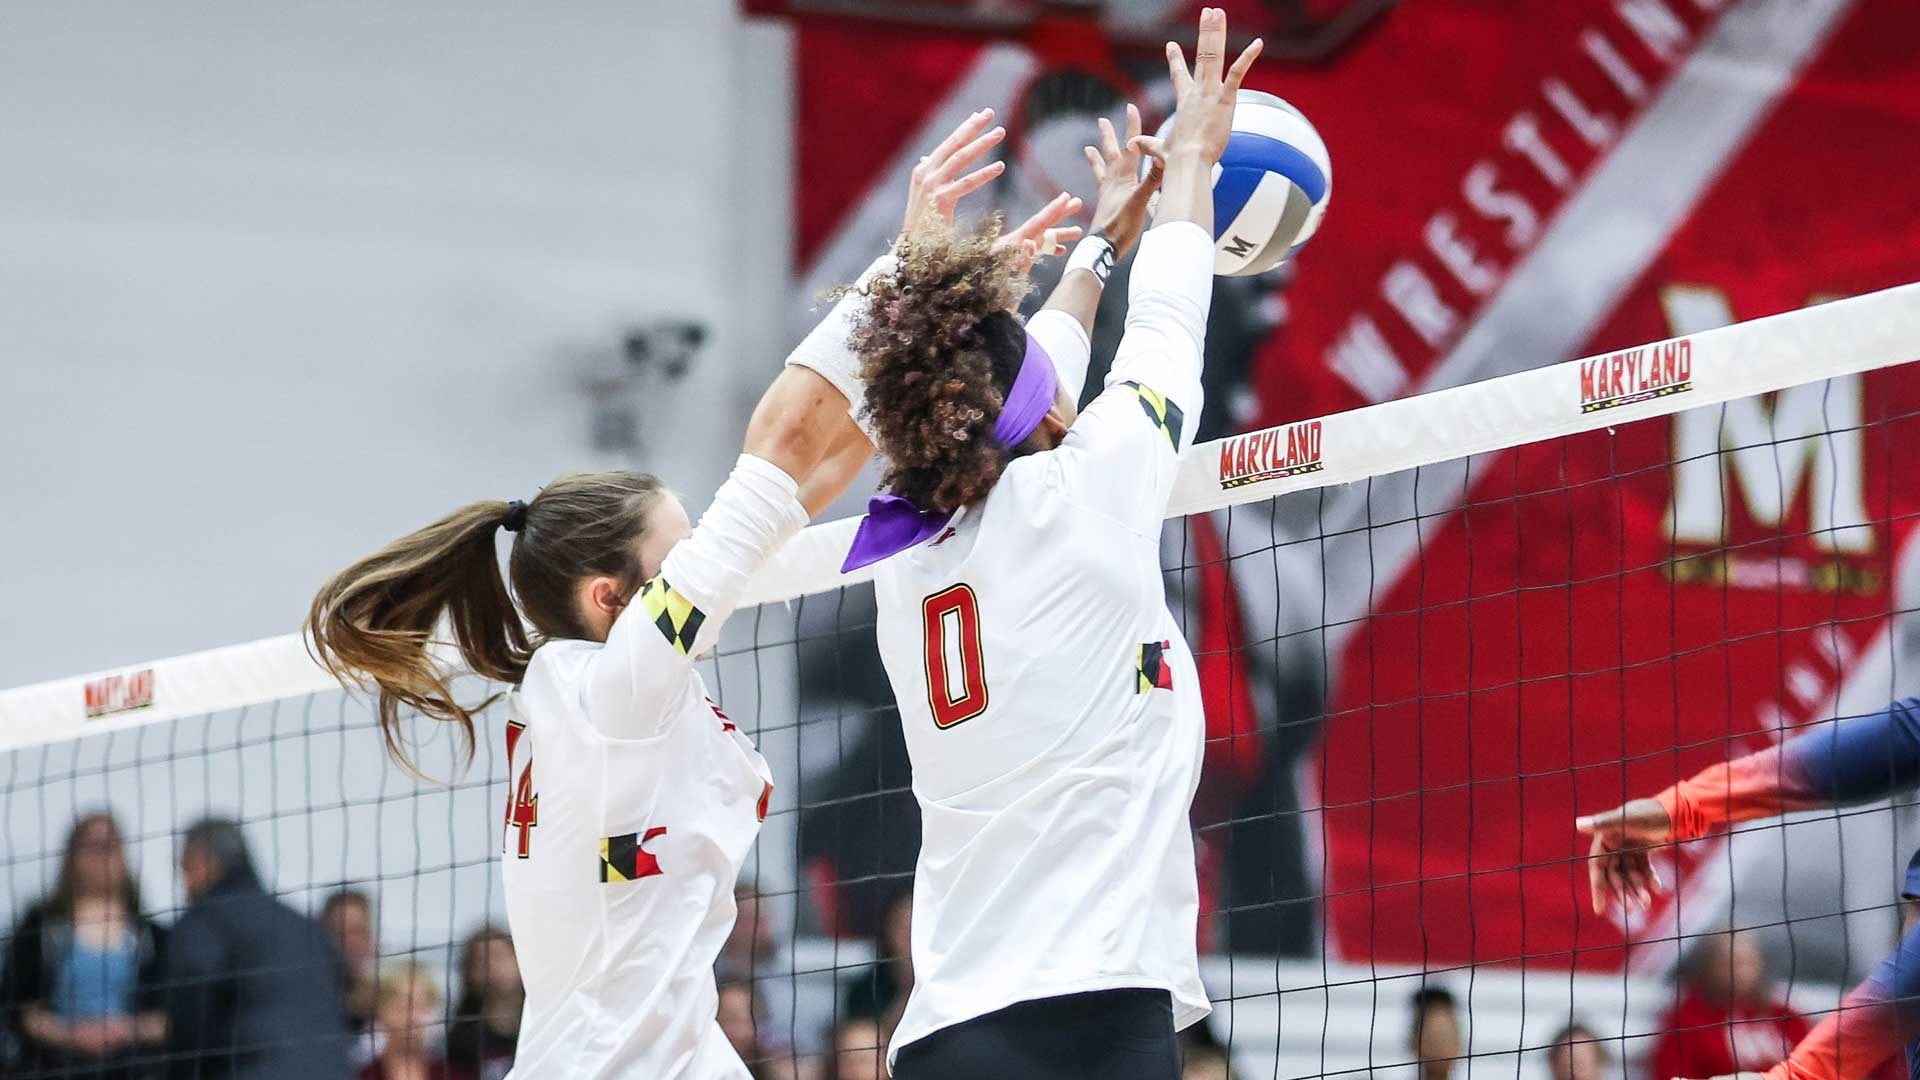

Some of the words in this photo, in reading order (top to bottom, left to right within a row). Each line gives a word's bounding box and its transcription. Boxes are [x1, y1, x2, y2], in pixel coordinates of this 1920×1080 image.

[1222, 235, 1257, 258] M
[1325, 0, 1720, 403] WRESTLIN
[1580, 339, 1691, 404] MARYLAND
[1662, 284, 1876, 554] M
[1220, 421, 1322, 481] MARYLAND
[922, 582, 989, 730] 0
